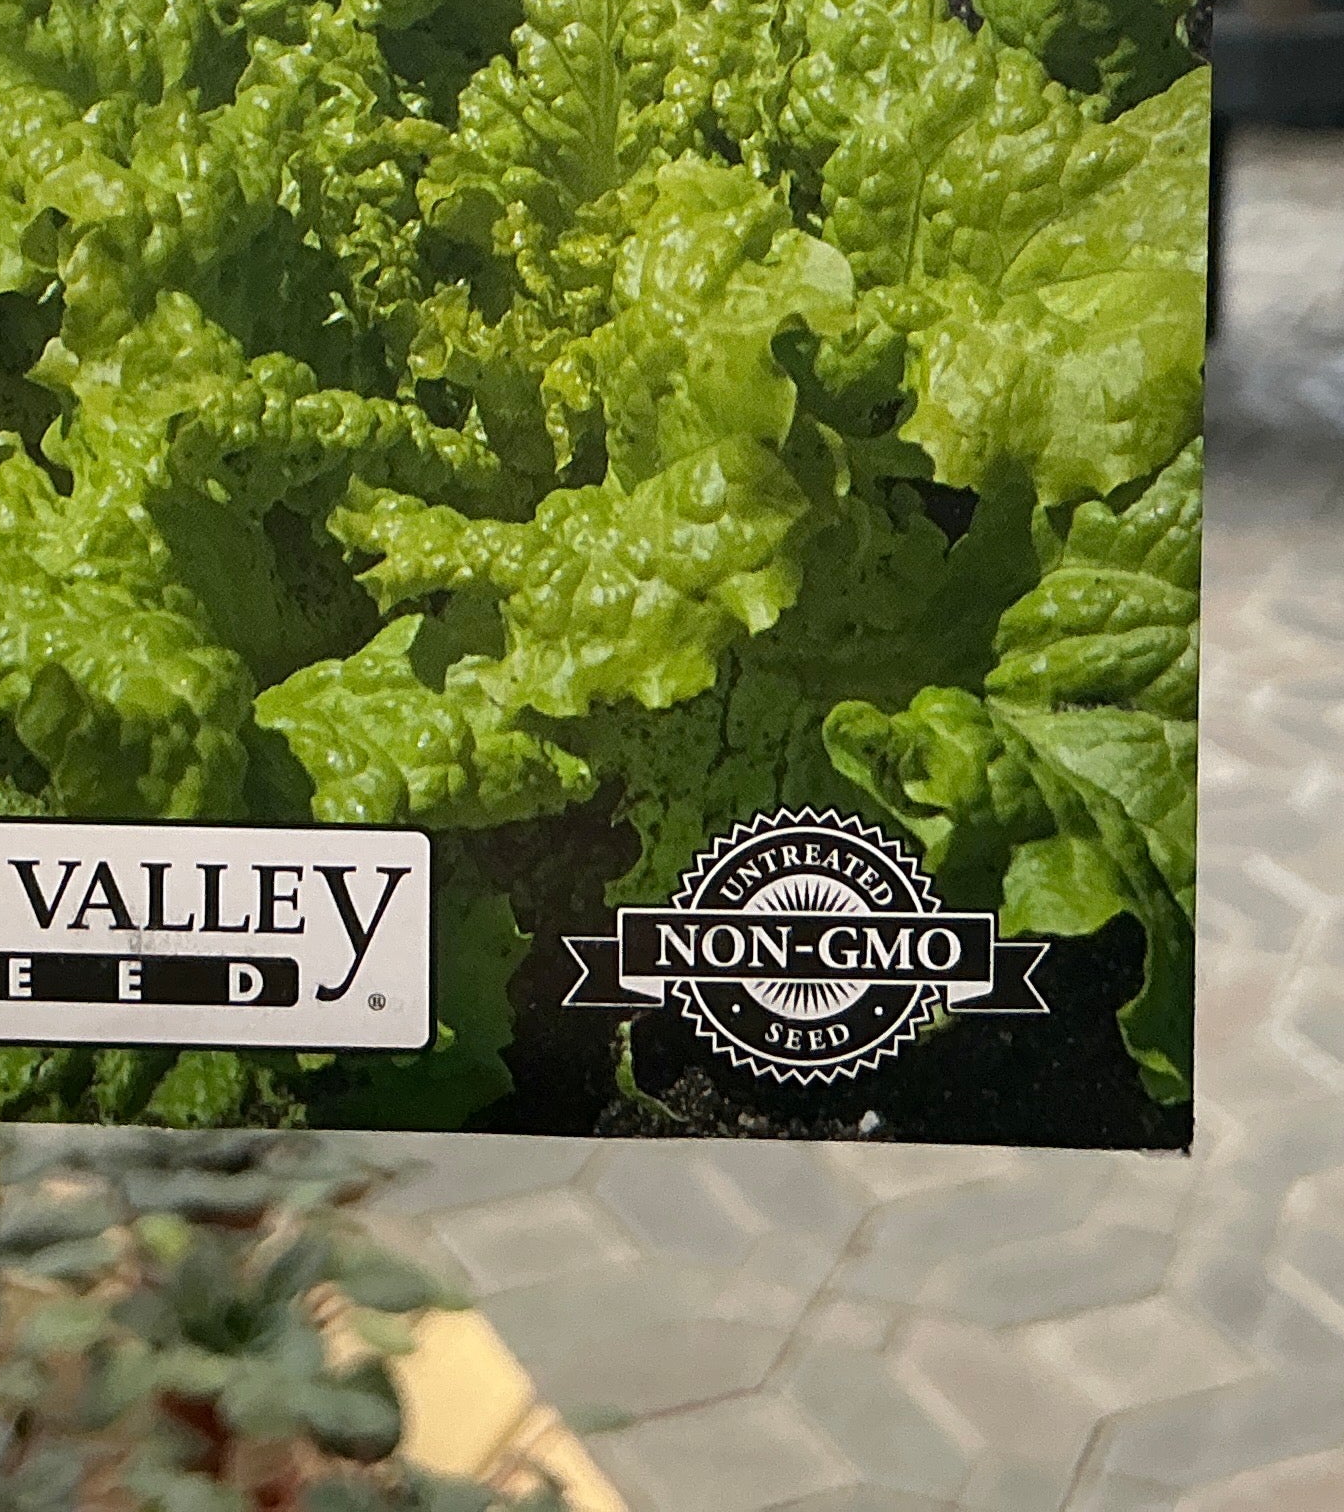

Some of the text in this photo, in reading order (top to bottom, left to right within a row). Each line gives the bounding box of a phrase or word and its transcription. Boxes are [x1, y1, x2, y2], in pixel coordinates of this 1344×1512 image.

[719, 843, 895, 907] UNTREATED
[655, 922, 962, 971] NON-GMO
[764, 1021, 851, 1052] SEED
